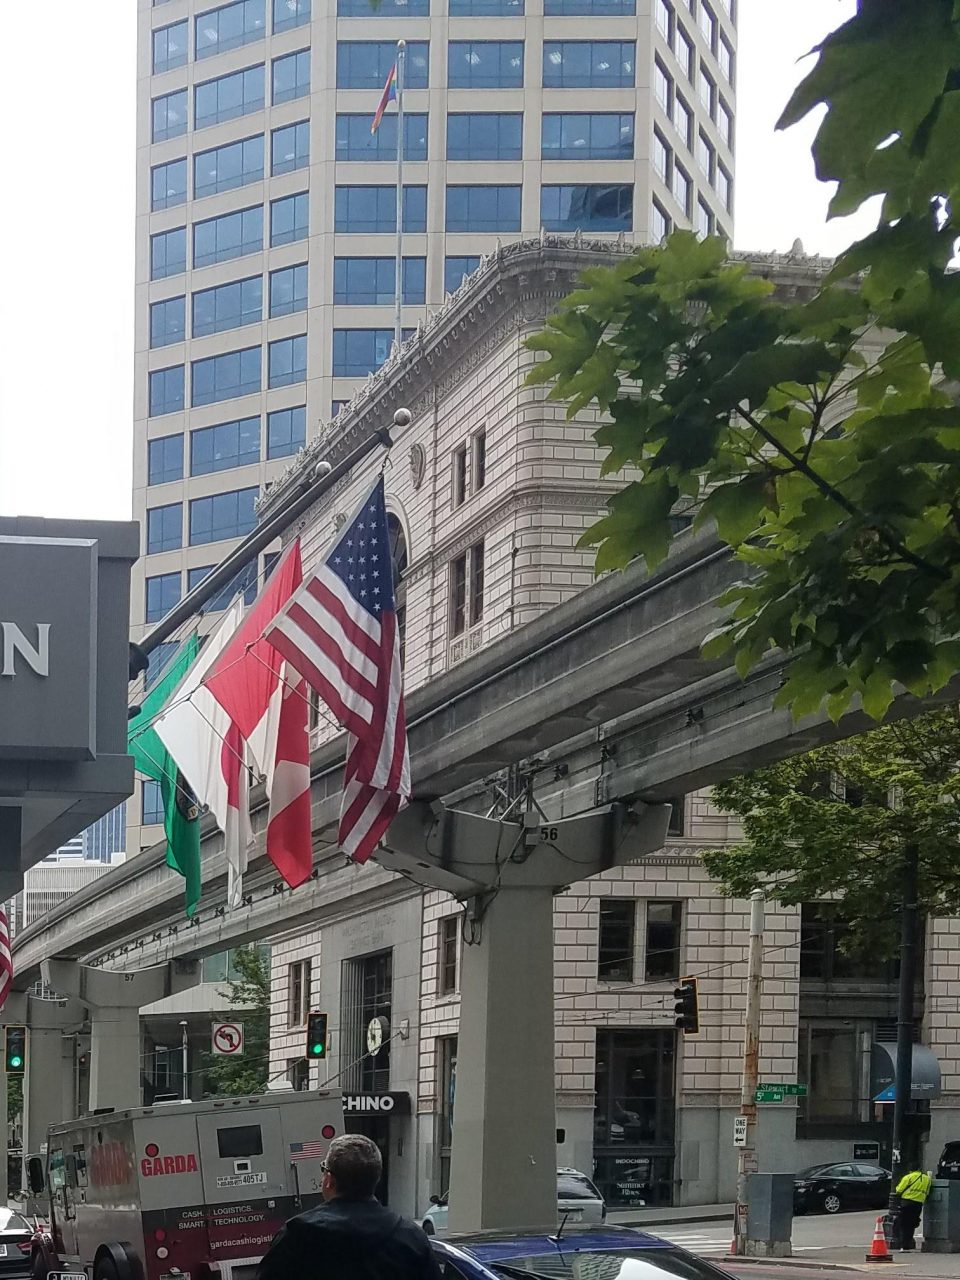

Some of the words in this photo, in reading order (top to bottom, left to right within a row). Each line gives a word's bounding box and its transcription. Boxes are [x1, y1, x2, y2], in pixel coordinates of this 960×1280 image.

[540, 827, 558, 841] 56
[125, 974, 135, 982] 57
[735, 1118, 746, 1127] ONE
[735, 1127, 746, 1135] WAY
[140, 1154, 199, 1177] GARDA
[242, 1173, 264, 1184] 405TJ
[182, 1210, 205, 1219] CASH.
[213, 1205, 253, 1216] LOGISTICS.
[178, 1220, 206, 1229] SMART.
[215, 1214, 265, 1226] TECHNOLOGY.
